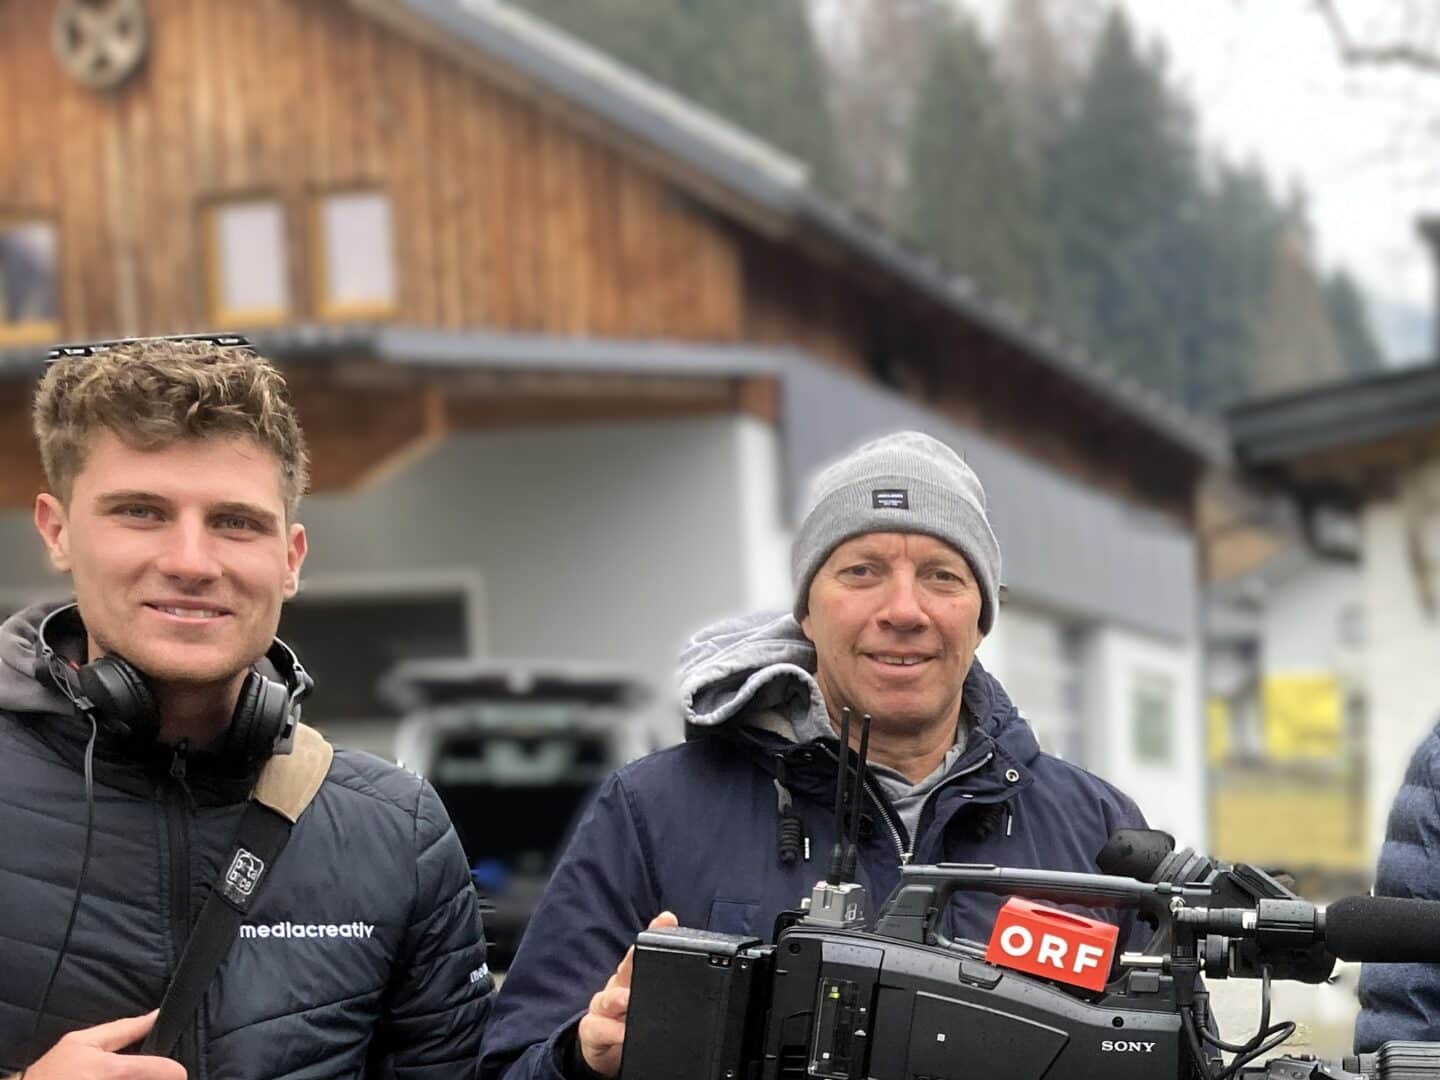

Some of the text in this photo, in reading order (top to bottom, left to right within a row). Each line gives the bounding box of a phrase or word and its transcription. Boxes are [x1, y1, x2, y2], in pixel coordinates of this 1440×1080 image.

[240, 921, 375, 939] mediacreativ
[1000, 925, 1104, 974] ORF
[1101, 1040, 1156, 1053] SONY
